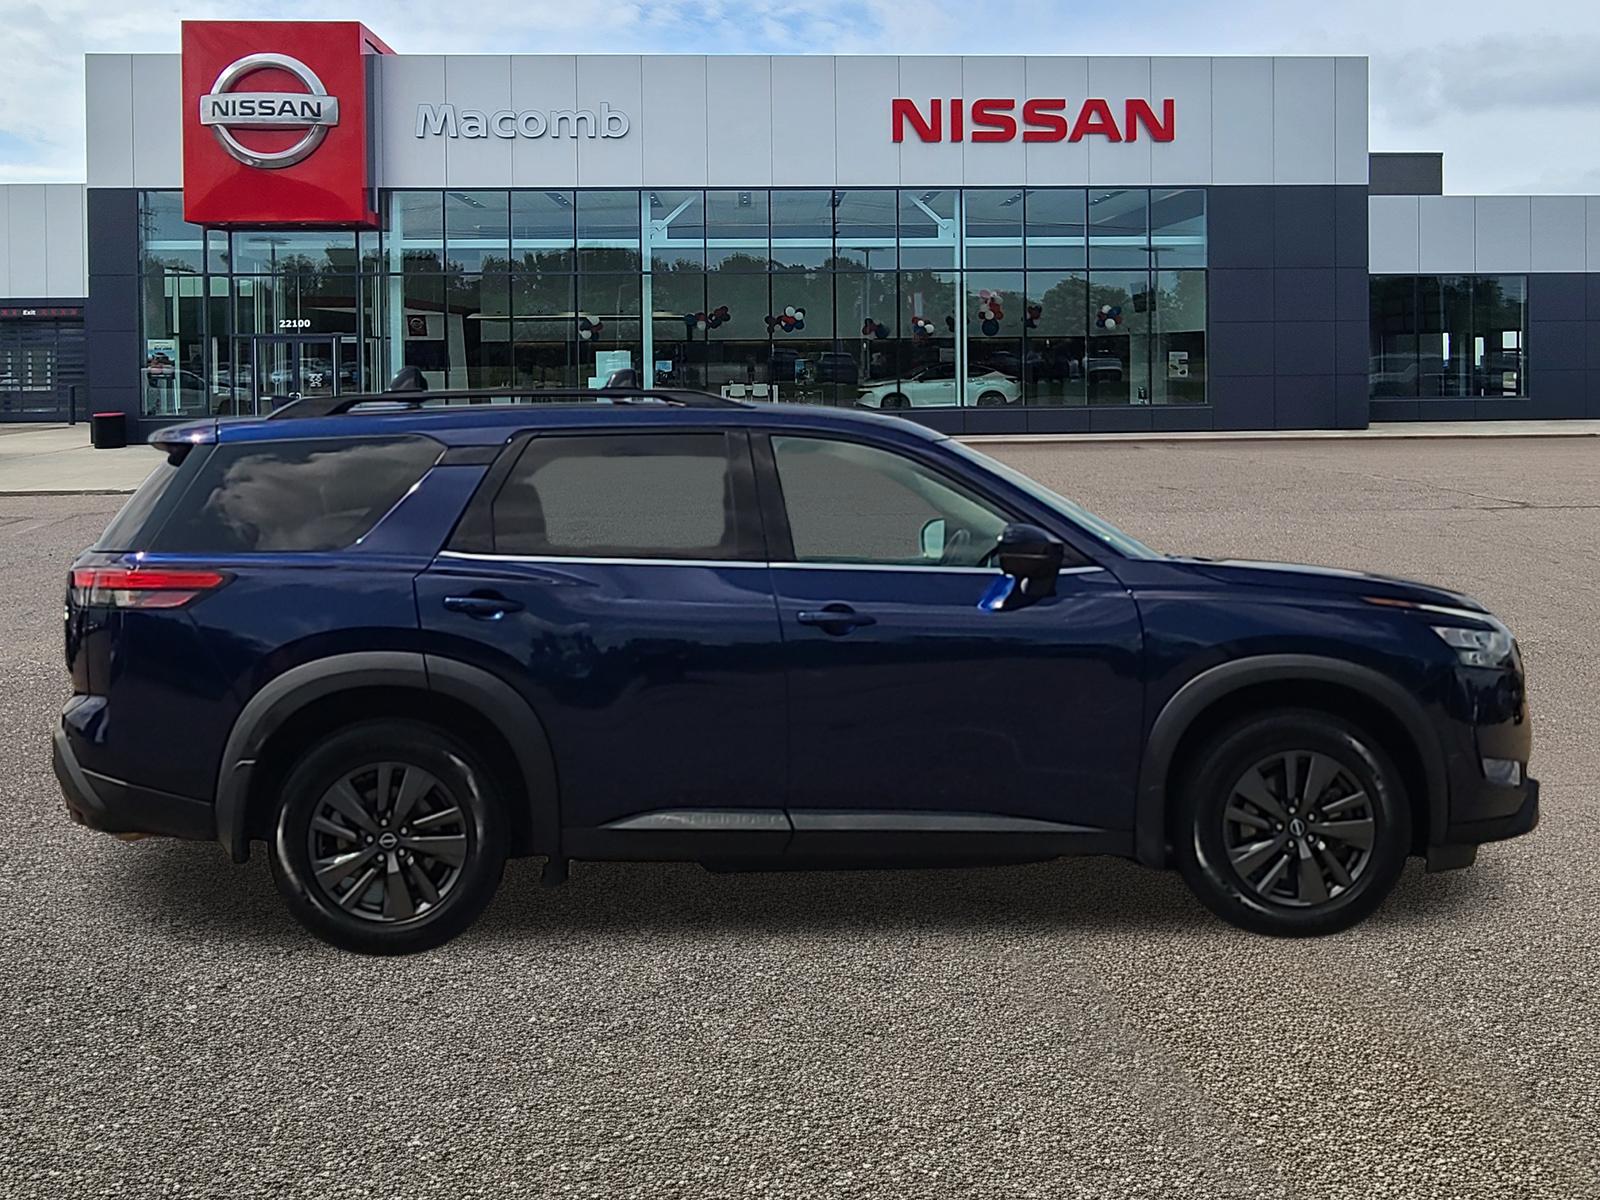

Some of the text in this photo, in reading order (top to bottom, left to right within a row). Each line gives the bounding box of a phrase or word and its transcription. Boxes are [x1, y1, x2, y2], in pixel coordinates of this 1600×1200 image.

[211, 100, 322, 118] NISSAN
[415, 102, 630, 139] Macomb
[892, 98, 1175, 142] NISSAN
[279, 319, 311, 328] 22100
